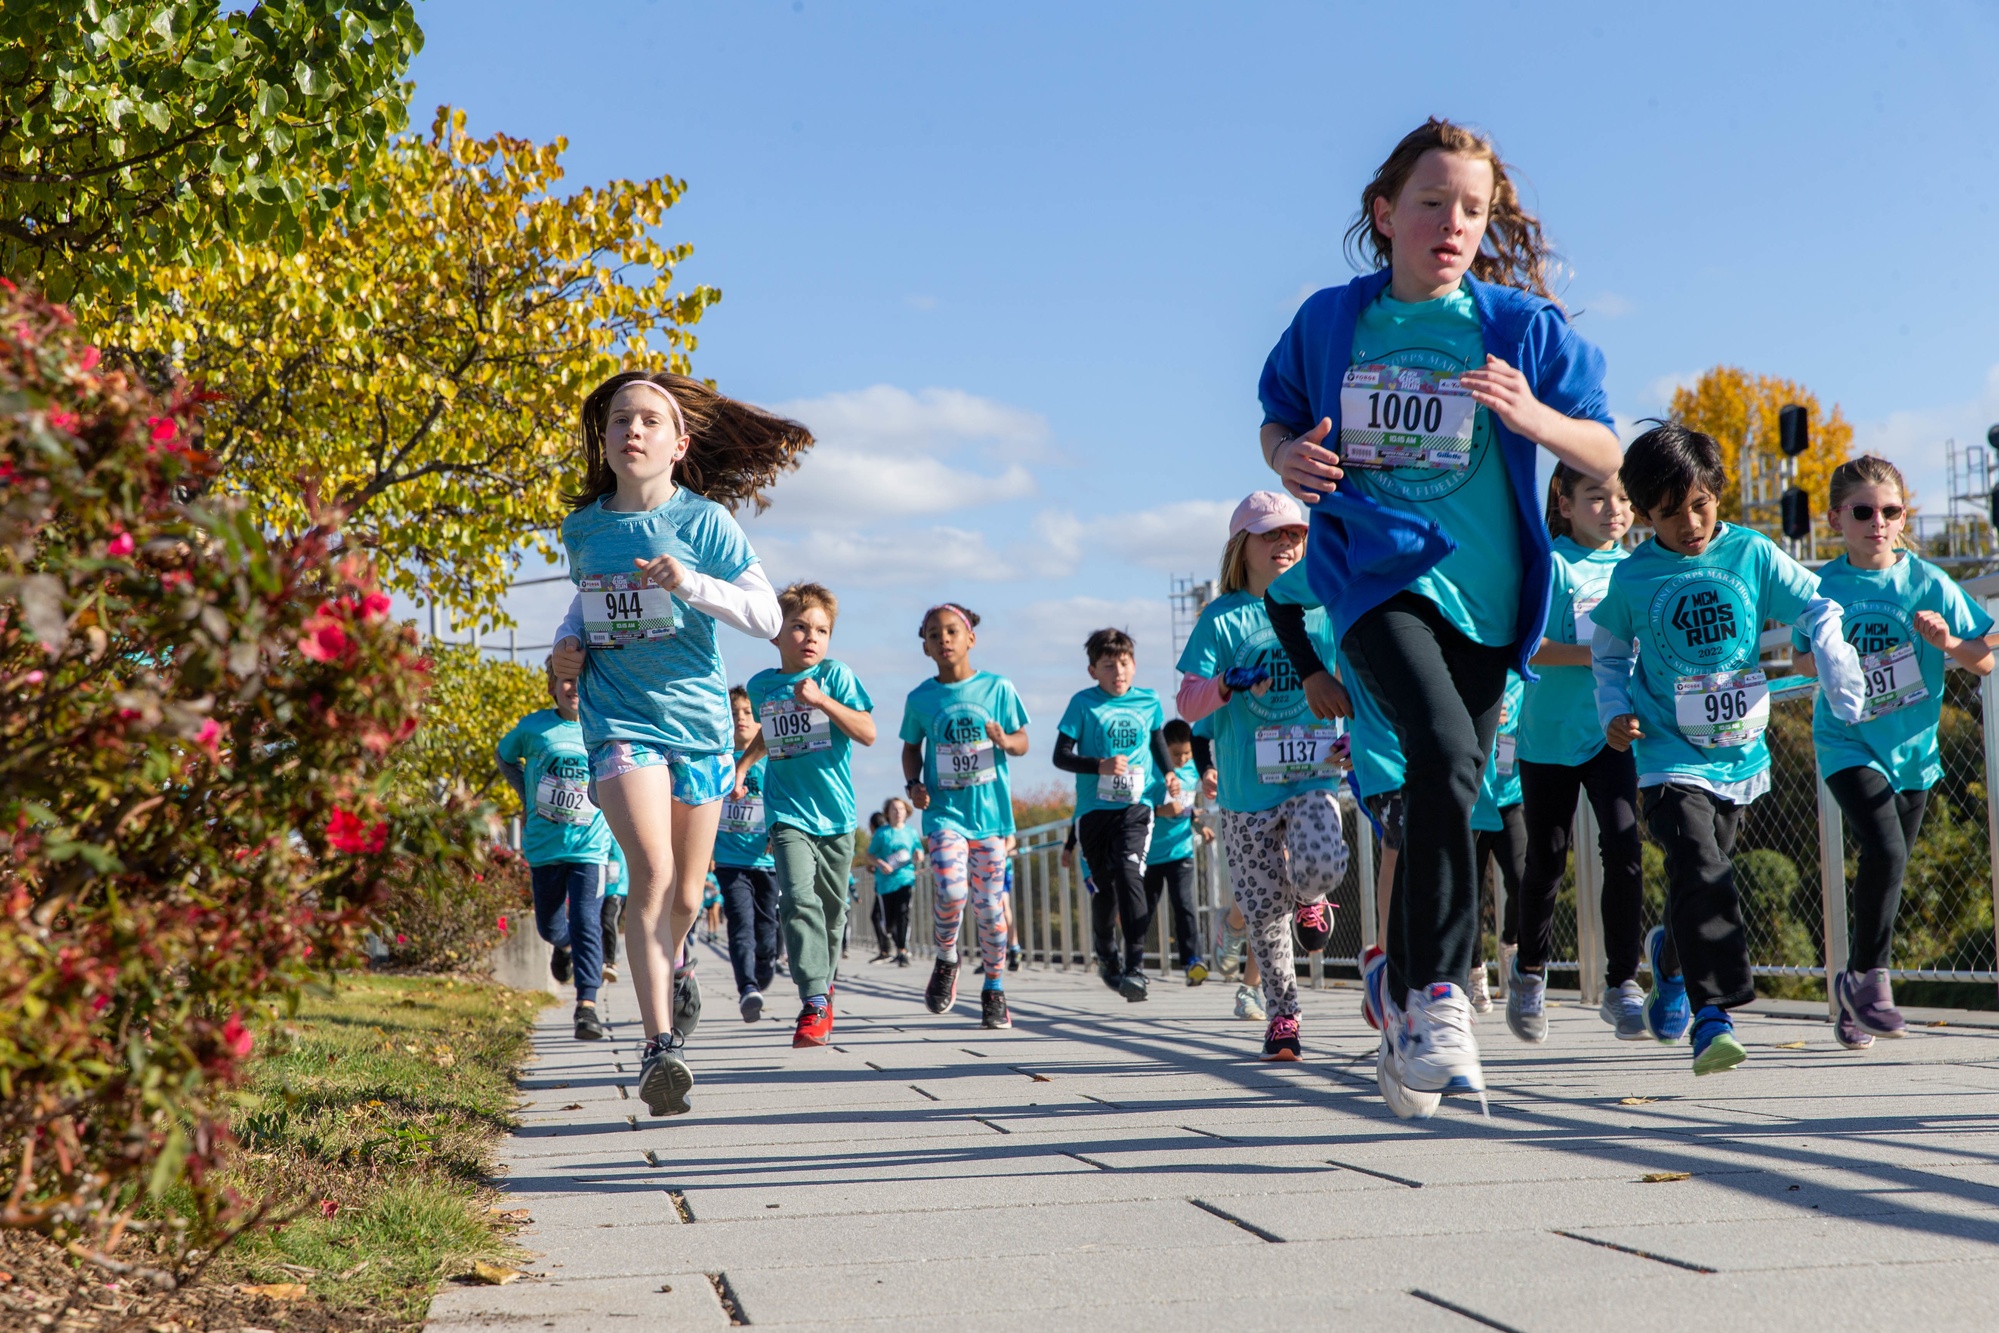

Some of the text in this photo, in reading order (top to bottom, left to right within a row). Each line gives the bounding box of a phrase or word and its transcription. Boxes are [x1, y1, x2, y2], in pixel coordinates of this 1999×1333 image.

[1367, 391, 1443, 433] 1000
[1406, 436, 1417, 444] AM
[1415, 469, 1466, 496] FIDELIS
[605, 592, 643, 620] 944
[1652, 570, 1751, 623] MARINE CORPS MARATHON
[1691, 589, 1719, 607] MCM
[1671, 595, 1734, 631] KIDS
[1685, 620, 1737, 647] RUN
[1865, 622, 1889, 636] MCM
[1697, 645, 1723, 658] 2022
[1716, 646, 1746, 674] FIDELIS
[1705, 689, 1748, 723] 996
[771, 712, 812, 738] 1098
[944, 719, 981, 742] KIDS
[1107, 720, 1137, 739] KIDS
[1112, 738, 1137, 749] RUN
[1278, 740, 1317, 764] 1137
[547, 756, 586, 779] KIDS
[952, 753, 979, 773] 992
[1112, 774, 1135, 790] 994
[549, 788, 584, 810] 1002
[727, 804, 754, 821] 1077
